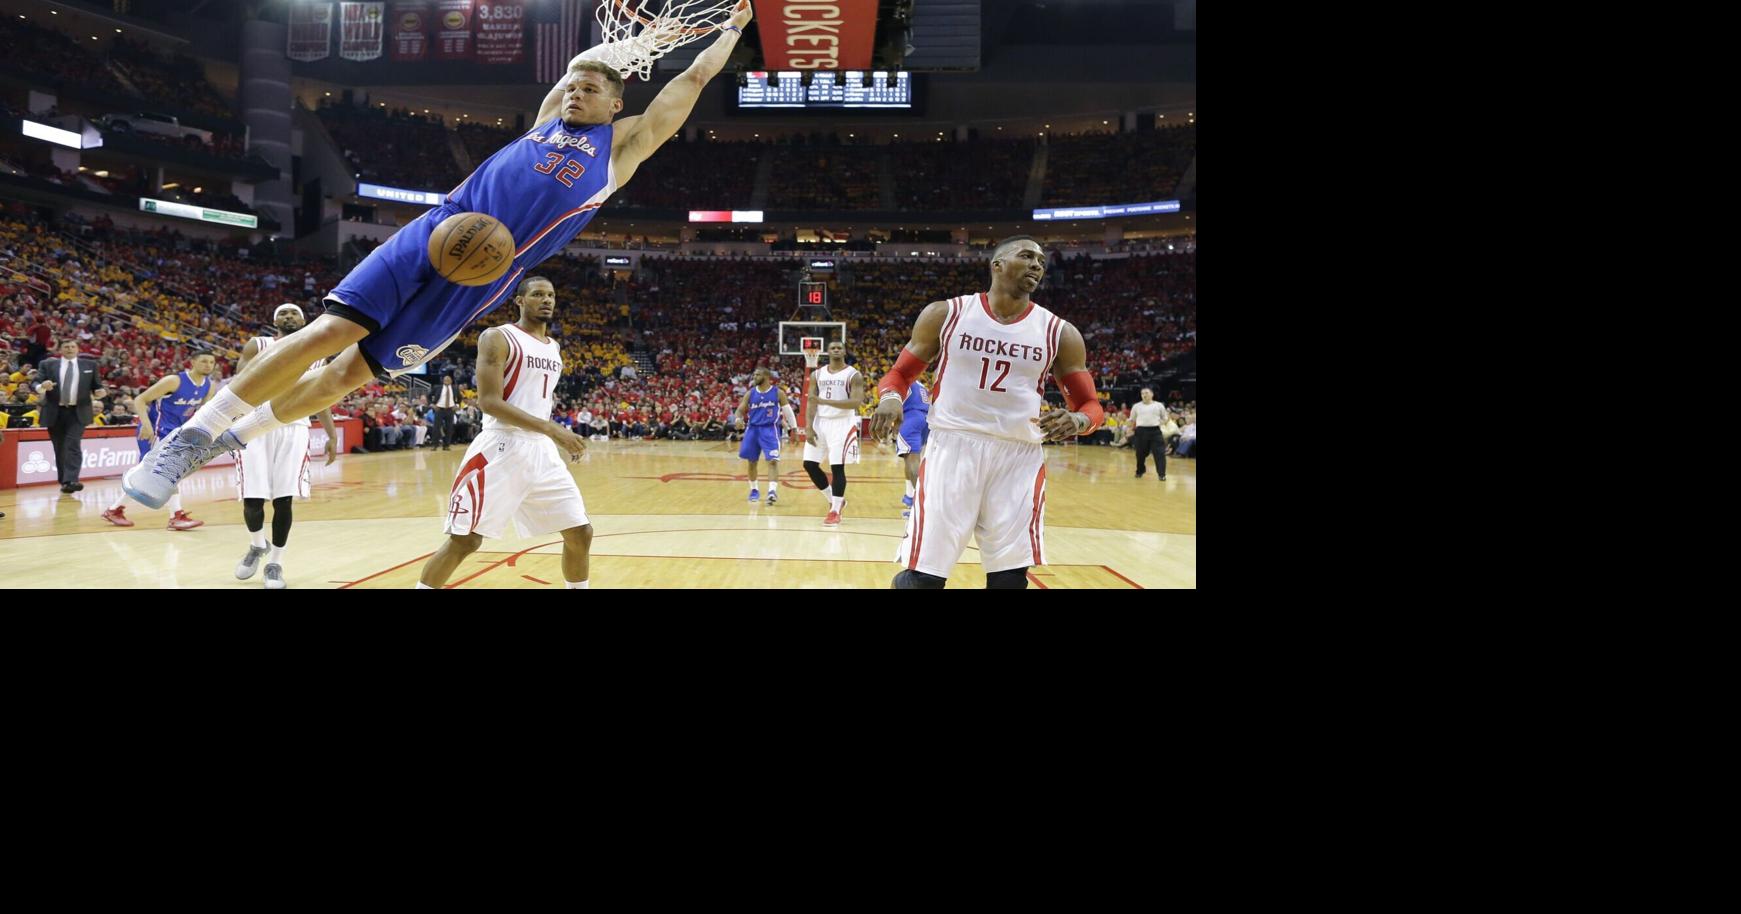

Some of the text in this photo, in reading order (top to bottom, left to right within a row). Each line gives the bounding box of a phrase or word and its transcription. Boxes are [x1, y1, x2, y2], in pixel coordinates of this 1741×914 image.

[479, 4, 523, 21] 3,830
[543, 130, 597, 158] Angeles
[534, 151, 586, 188] 32
[376, 188, 424, 202] UNITED
[809, 291, 822, 304] 18
[959, 332, 1043, 362] ROCKETS
[542, 373, 549, 399] 1
[977, 356, 1012, 394] 12
[826, 386, 832, 399] 6
